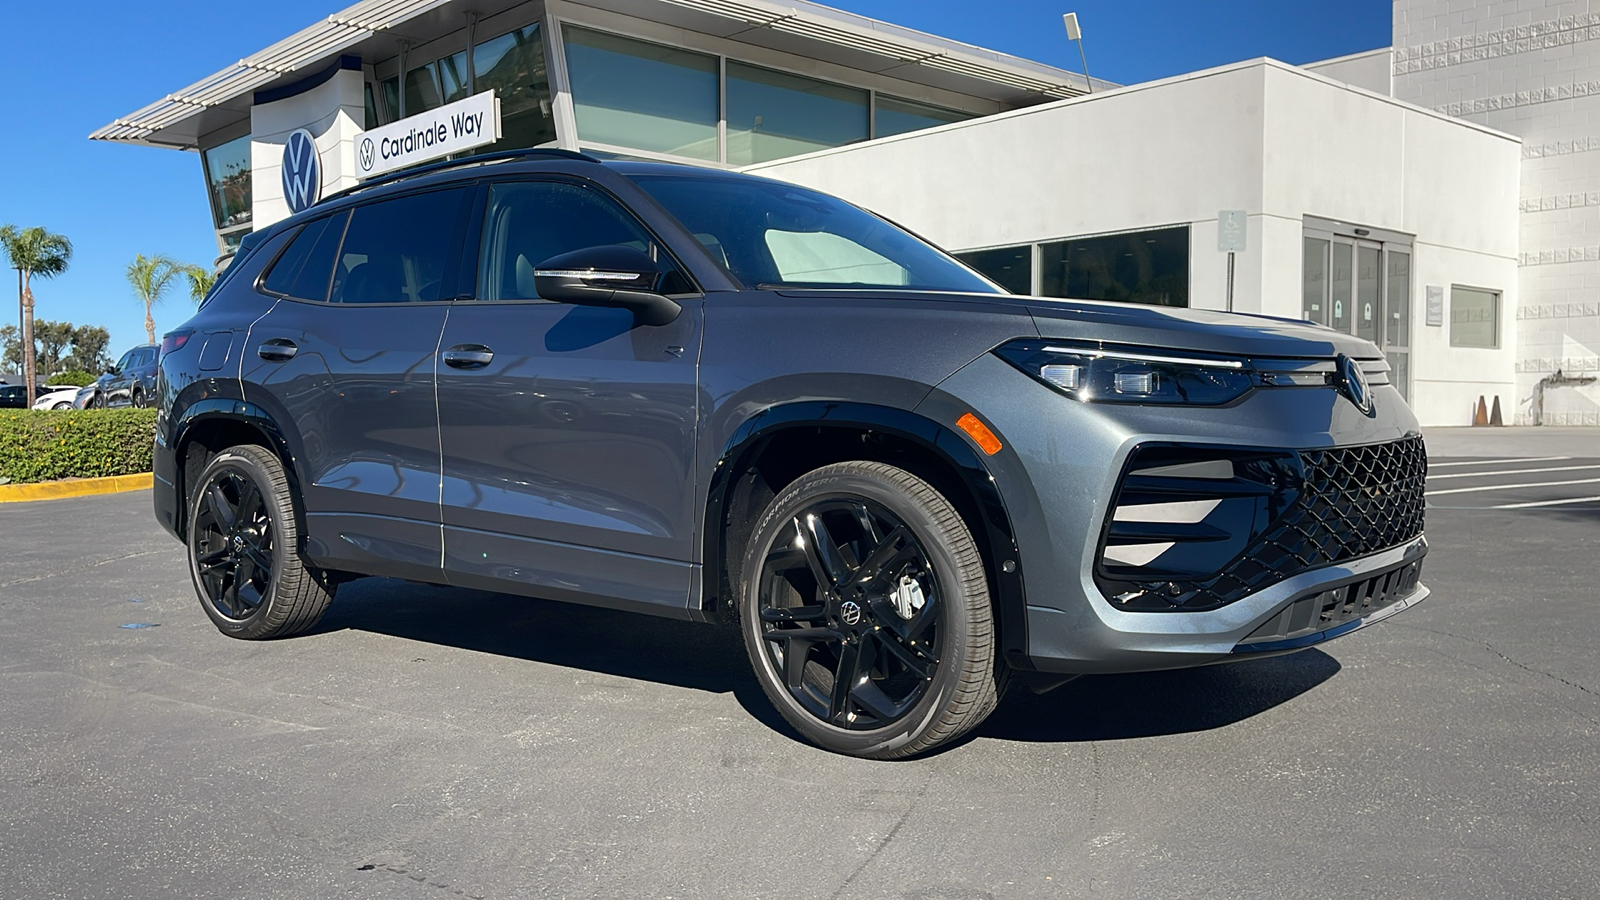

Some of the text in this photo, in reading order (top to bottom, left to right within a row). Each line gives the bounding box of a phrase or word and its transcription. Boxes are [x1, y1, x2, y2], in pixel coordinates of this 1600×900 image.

[381, 123, 447, 160] Cardinale
[451, 111, 484, 138] Way
[754, 487, 800, 544] SCORPION
[803, 476, 839, 491] ZERO
